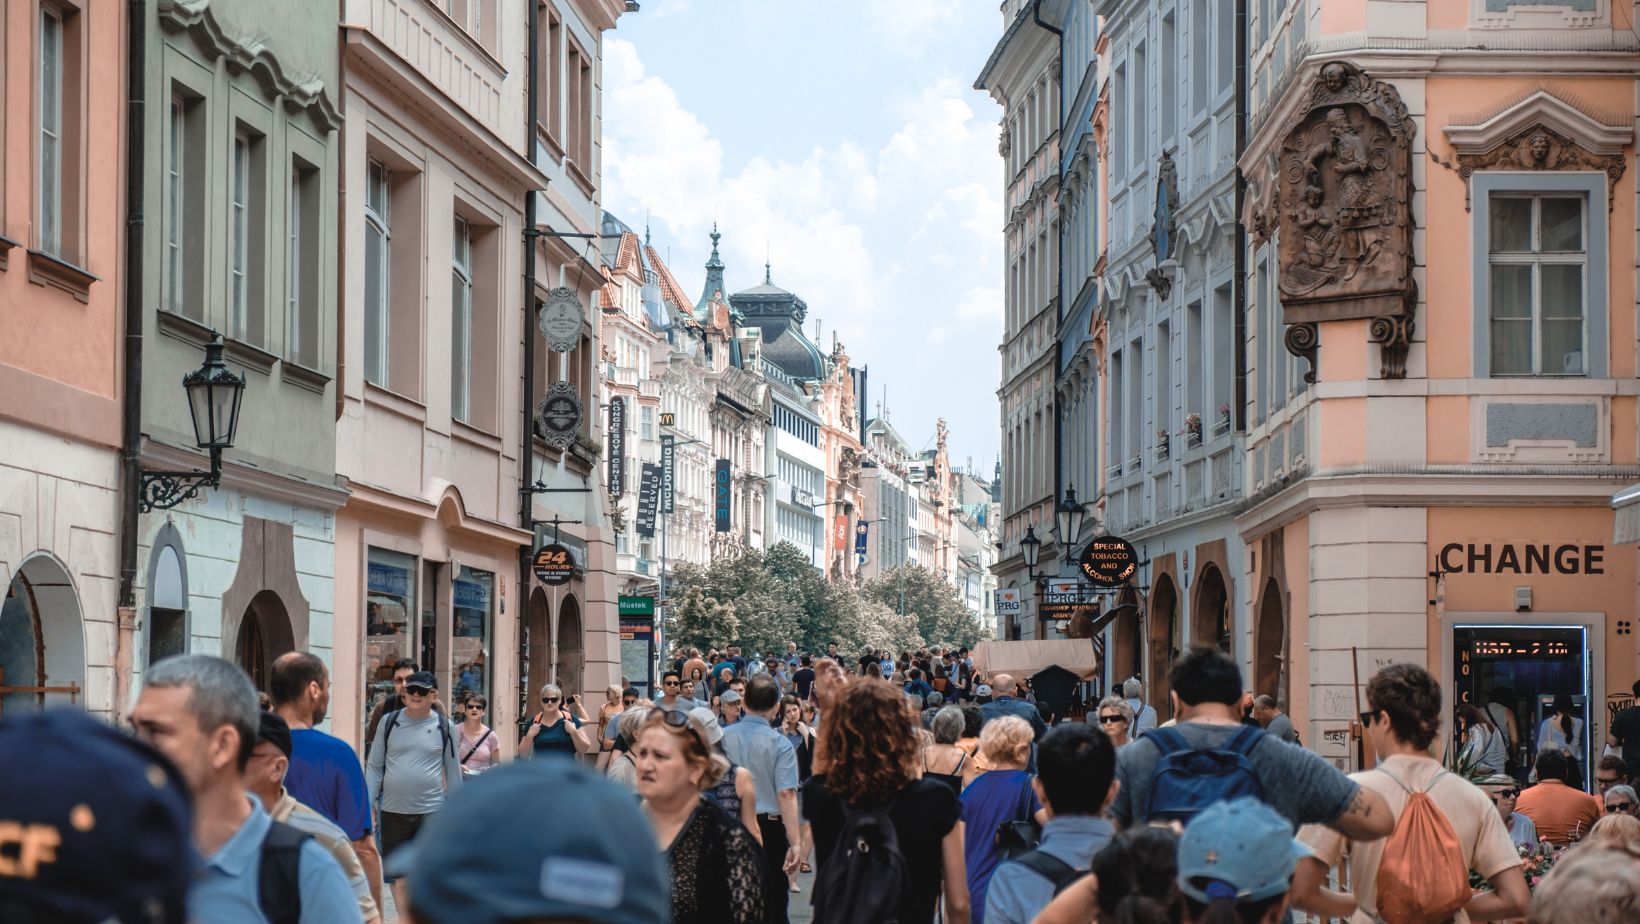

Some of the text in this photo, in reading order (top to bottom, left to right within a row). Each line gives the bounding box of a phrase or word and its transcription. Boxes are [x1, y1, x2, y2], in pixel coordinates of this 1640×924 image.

[646, 476, 659, 529] RESERVED
[717, 470, 728, 519] GATE
[538, 551, 567, 564] 24
[1101, 562, 1118, 570] AND
[1440, 543, 1604, 575] CHANGE
[1082, 562, 1135, 582] ALCOHOL SHOP
[996, 602, 1020, 611] PRG
